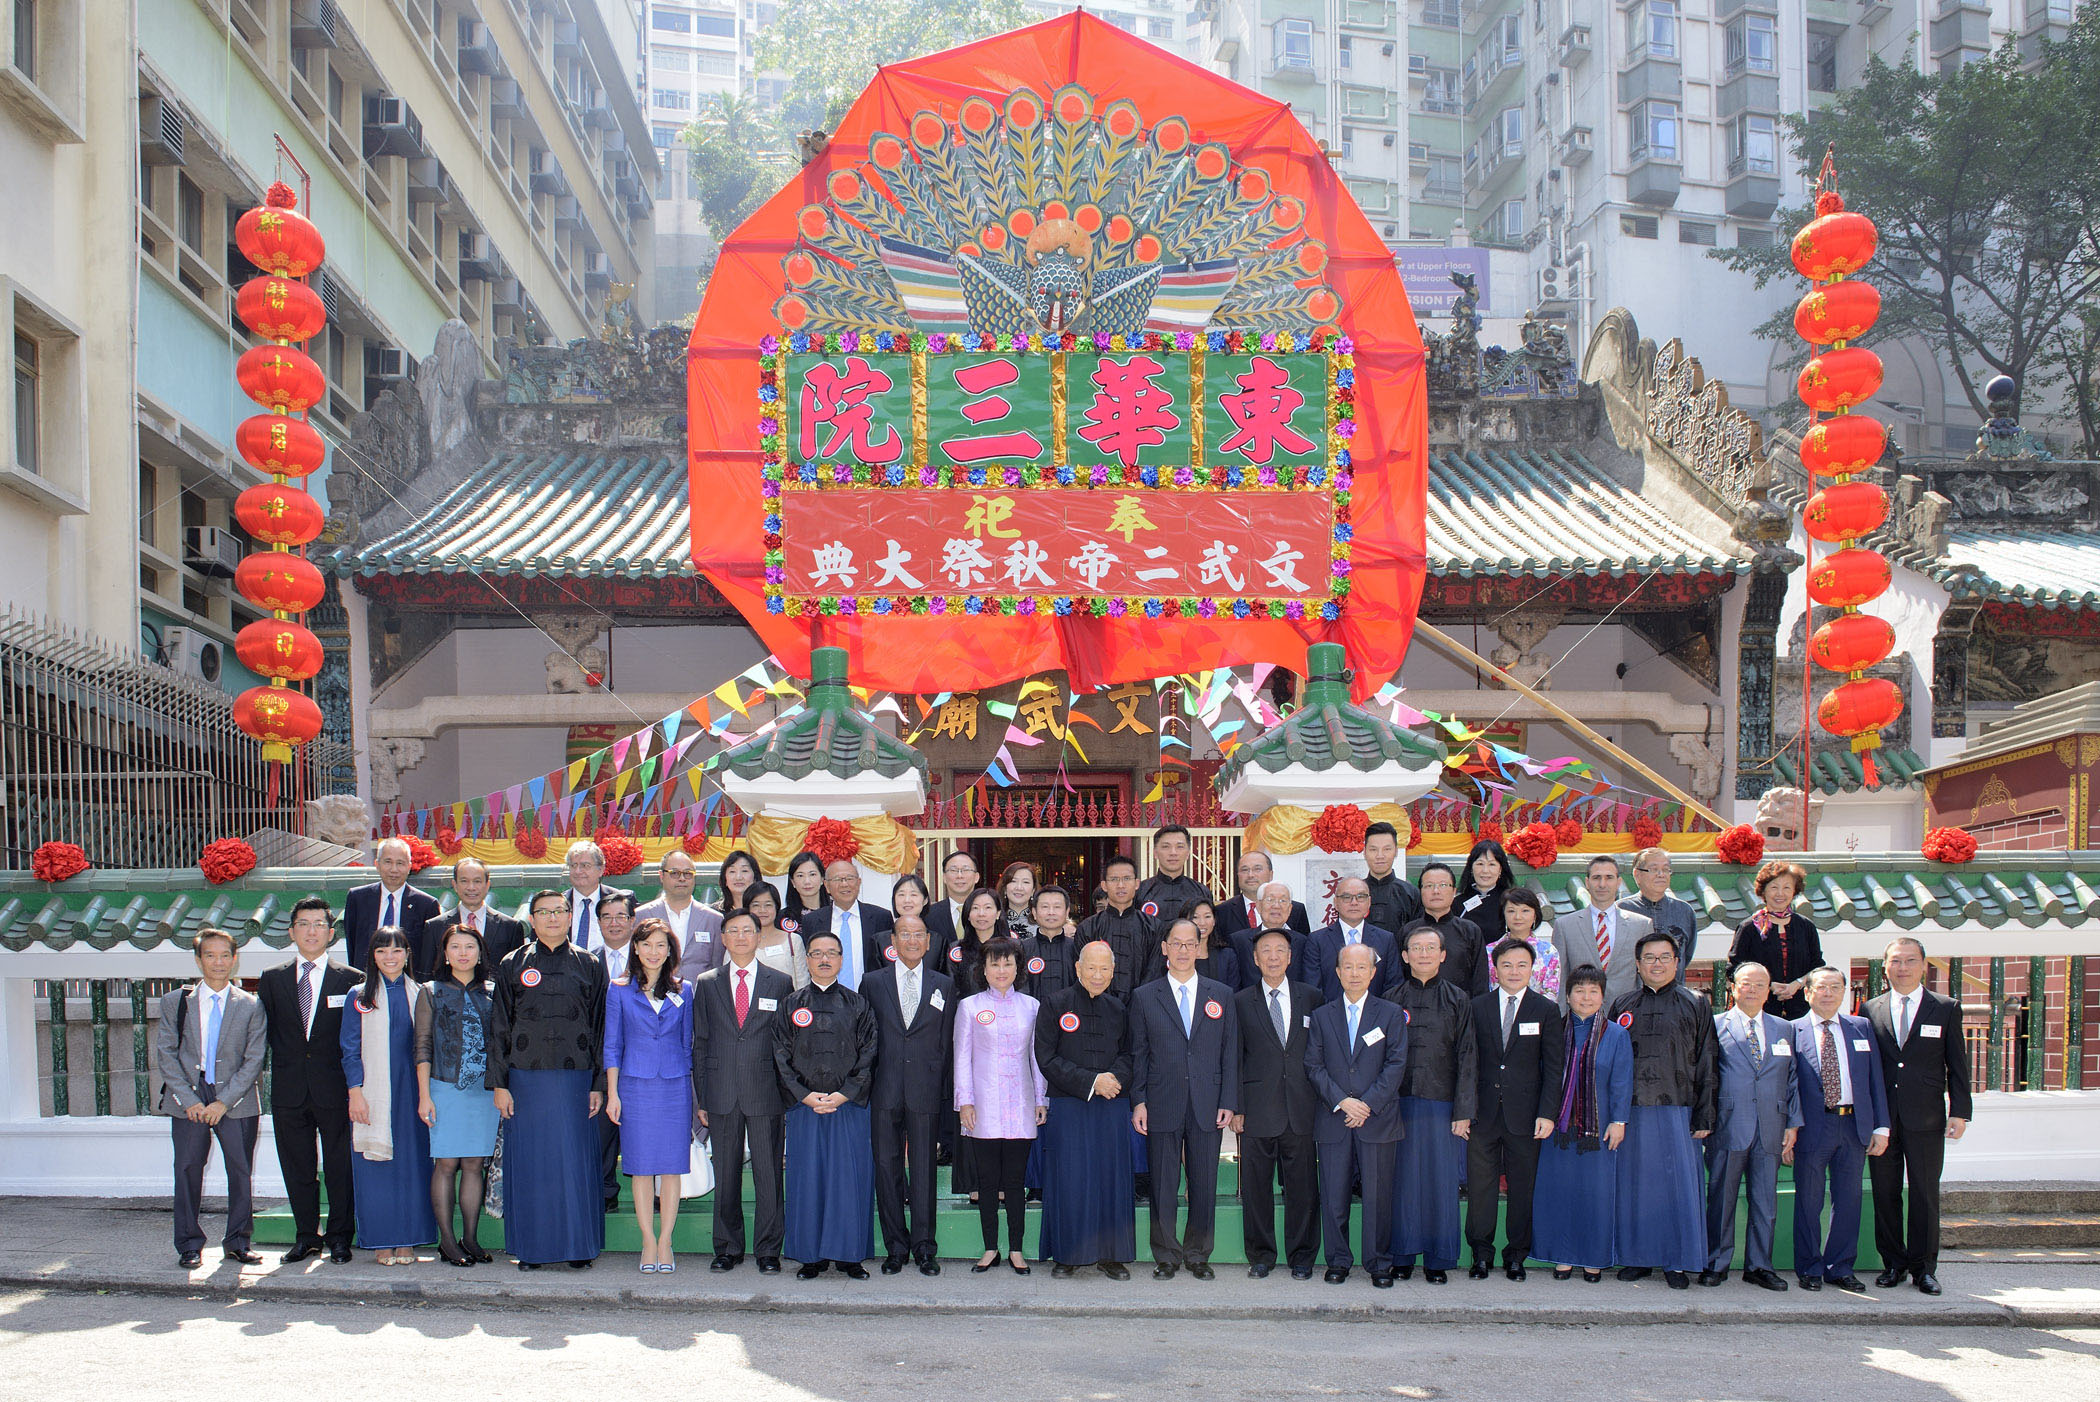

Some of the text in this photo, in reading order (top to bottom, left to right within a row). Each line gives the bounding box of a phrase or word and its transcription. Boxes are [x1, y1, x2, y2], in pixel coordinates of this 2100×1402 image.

[1417, 262, 1442, 271] Upper
[1445, 261, 1472, 270] Floors
[800, 355, 1317, 466] 東華三院
[807, 538, 1311, 592] 文武二帝秋祭大典
